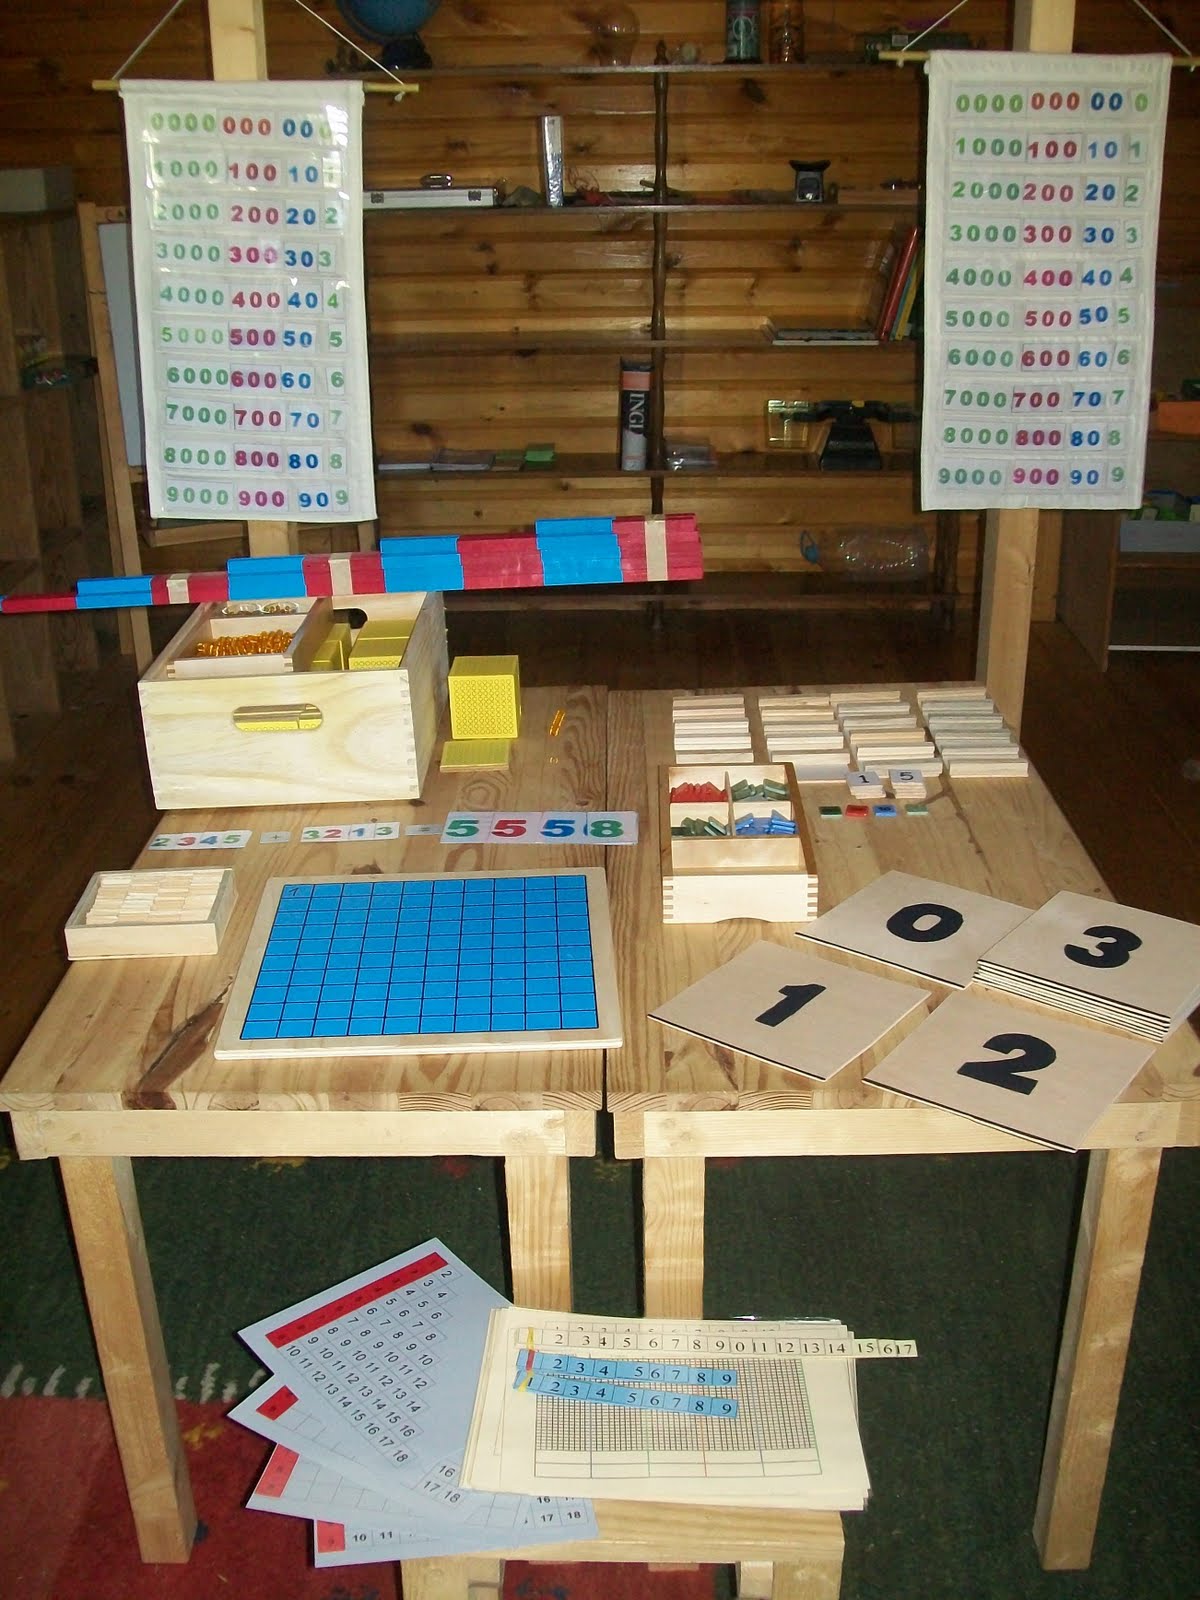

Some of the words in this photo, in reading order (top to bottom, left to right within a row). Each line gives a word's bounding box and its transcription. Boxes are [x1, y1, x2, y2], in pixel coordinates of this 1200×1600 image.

[956, 94, 1023, 113] 0000
[1032, 92, 1080, 111] 000
[1091, 92, 1123, 111] 00
[1135, 93, 1148, 112] 0
[151, 112, 215, 133] 0000
[223, 117, 272, 136] 000
[283, 119, 313, 138] 00
[955, 137, 1022, 157] 1000
[1028, 140, 1077, 158] 100
[1088, 142, 1117, 159] 10
[1130, 140, 1140, 158] 1
[155, 160, 218, 179] 1000
[228, 163, 276, 181] 100
[289, 166, 318, 183] 10
[952, 181, 1019, 200] 2000
[1024, 182, 1073, 202] 200
[1086, 183, 1115, 201] 20
[1125, 185, 1138, 202] 2
[156, 202, 219, 222] 2000
[231, 205, 278, 225] 200
[286, 208, 316, 225] 20
[325, 208, 338, 224] 2
[950, 224, 1016, 244] 3000
[1023, 224, 1071, 244] 300
[1084, 226, 1114, 245] 30
[1126, 227, 1138, 243] 3
[156, 242, 220, 262] 3000
[229, 247, 278, 264] 300
[284, 249, 313, 267] 30
[319, 251, 331, 267] 3
[946, 268, 1011, 287] 4000
[1024, 269, 1072, 287] 400
[1081, 269, 1111, 286] 40
[1120, 267, 1133, 284] 4
[160, 286, 224, 306] 4000
[232, 291, 280, 309] 400
[287, 292, 318, 308] 40
[327, 293, 338, 308] 4
[945, 310, 1009, 327] 5000
[1025, 310, 1071, 327] 500
[1079, 307, 1108, 325] 50
[1119, 308, 1130, 323] 5
[161, 327, 223, 346] 5000
[230, 328, 276, 346] 500
[283, 330, 312, 348] 50
[329, 331, 342, 347] 5
[948, 348, 1013, 367] 6000
[1022, 349, 1070, 367] 600
[1078, 351, 1107, 368] 60
[1117, 349, 1130, 365] 6
[167, 367, 229, 385] 6000
[231, 371, 277, 388] 600
[281, 372, 311, 388] 60
[331, 371, 344, 388] 6
[945, 389, 1006, 408] 7000
[1013, 391, 1060, 408] 700
[1073, 391, 1101, 407] 70
[1113, 389, 1125, 405] 7
[166, 404, 227, 425] 7000
[235, 409, 281, 427] 700
[290, 412, 319, 428] 70
[330, 409, 342, 425] 7
[944, 426, 1008, 445] 8000
[1016, 429, 1061, 446] 800
[1071, 430, 1099, 447] 80
[1108, 429, 1120, 446] 8
[164, 446, 226, 466] 8000
[235, 451, 279, 467] 800
[289, 453, 318, 469] 80
[329, 452, 342, 469] 8
[939, 467, 1002, 486] 9000
[1013, 467, 1059, 486] 900
[1071, 470, 1099, 486] 90
[1111, 466, 1124, 483] 9
[167, 486, 228, 505] 9000
[239, 490, 284, 507] 900
[299, 492, 329, 508] 90
[336, 489, 349, 505] 9
[859, 775, 869, 783] 1
[900, 772, 913, 780] 5
[288, 887, 299, 896] 1
[886, 903, 963, 942] 0
[1064, 926, 1142, 968] 3
[755, 984, 826, 1027] 1
[957, 1033, 1056, 1095] 2
[555, 1335, 563, 1344] 2
[583, 1335, 590, 1345] 3
[600, 1337, 607, 1346] 4
[623, 1338, 631, 1347] 5
[650, 1339, 657, 1348] 6
[672, 1339, 679, 1349] 7
[693, 1340, 701, 1349] 8
[716, 1341, 724, 1351] 9
[753, 1342, 766, 1352] 11
[778, 1343, 794, 1353] 12
[803, 1343, 820, 1353] 13
[829, 1344, 845, 1353] 14
[858, 1343, 874, 1353] 15
[896, 1344, 911, 1354] 17
[553, 1359, 562, 1368] 2
[576, 1363, 584, 1372] 3
[599, 1366, 608, 1375] 4
[635, 1367, 643, 1377] 5
[651, 1368, 660, 1378] 6
[673, 1370, 680, 1379] 7
[697, 1373, 706, 1382] 8
[723, 1374, 732, 1383] 9
[320, 1348, 333, 1359] 10
[332, 1361, 345, 1371] 11
[346, 1373, 359, 1384] 12
[358, 1386, 372, 1397] 13
[372, 1399, 386, 1410] 14
[386, 1412, 400, 1424] 15
[401, 1425, 414, 1436] 16
[551, 1382, 560, 1391] 2
[570, 1386, 579, 1395] 3
[596, 1387, 606, 1397] 4
[627, 1393, 636, 1403] 5
[650, 1395, 660, 1405] 6
[673, 1398, 680, 1407] 7
[695, 1401, 704, 1411] 8
[723, 1404, 731, 1414] 9
[287, 1346, 300, 1356] 10
[300, 1358, 312, 1368] 11
[312, 1371, 326, 1382] 12
[325, 1384, 339, 1395] 13
[338, 1397, 352, 1408] 14
[351, 1410, 366, 1421] 15
[365, 1423, 379, 1434] 16
[379, 1436, 394, 1447] 17
[393, 1450, 408, 1462] 18
[440, 1466, 455, 1477] 16
[424, 1481, 440, 1492] 17
[445, 1491, 460, 1502] 18
[541, 1514, 553, 1522] 17
